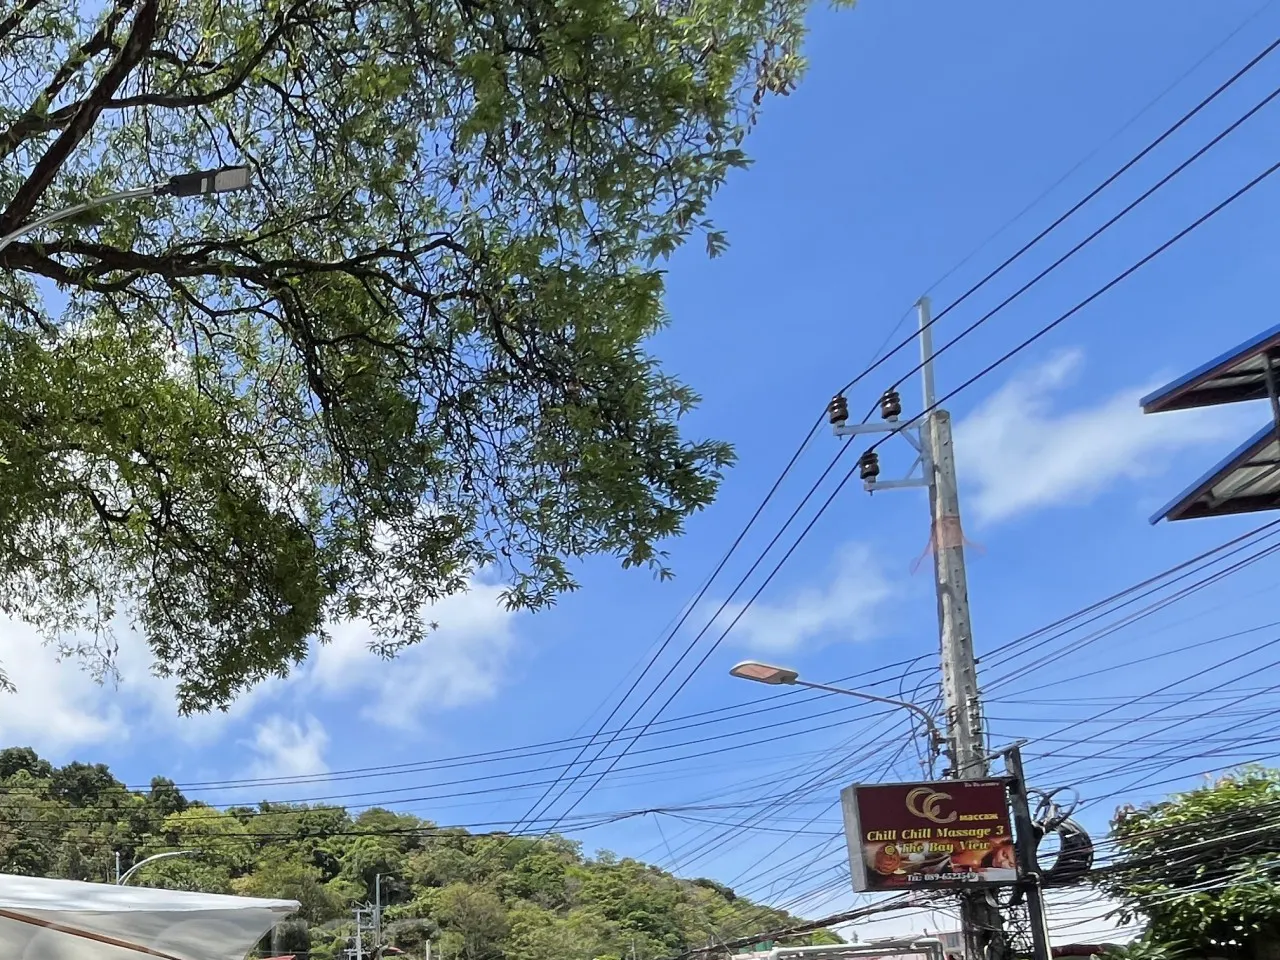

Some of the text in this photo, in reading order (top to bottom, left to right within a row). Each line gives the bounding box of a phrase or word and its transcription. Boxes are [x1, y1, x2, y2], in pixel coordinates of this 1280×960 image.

[867, 825, 1004, 841] Chill Chill Massage 3
[929, 842, 954, 853] Bay
[959, 841, 991, 850] View
